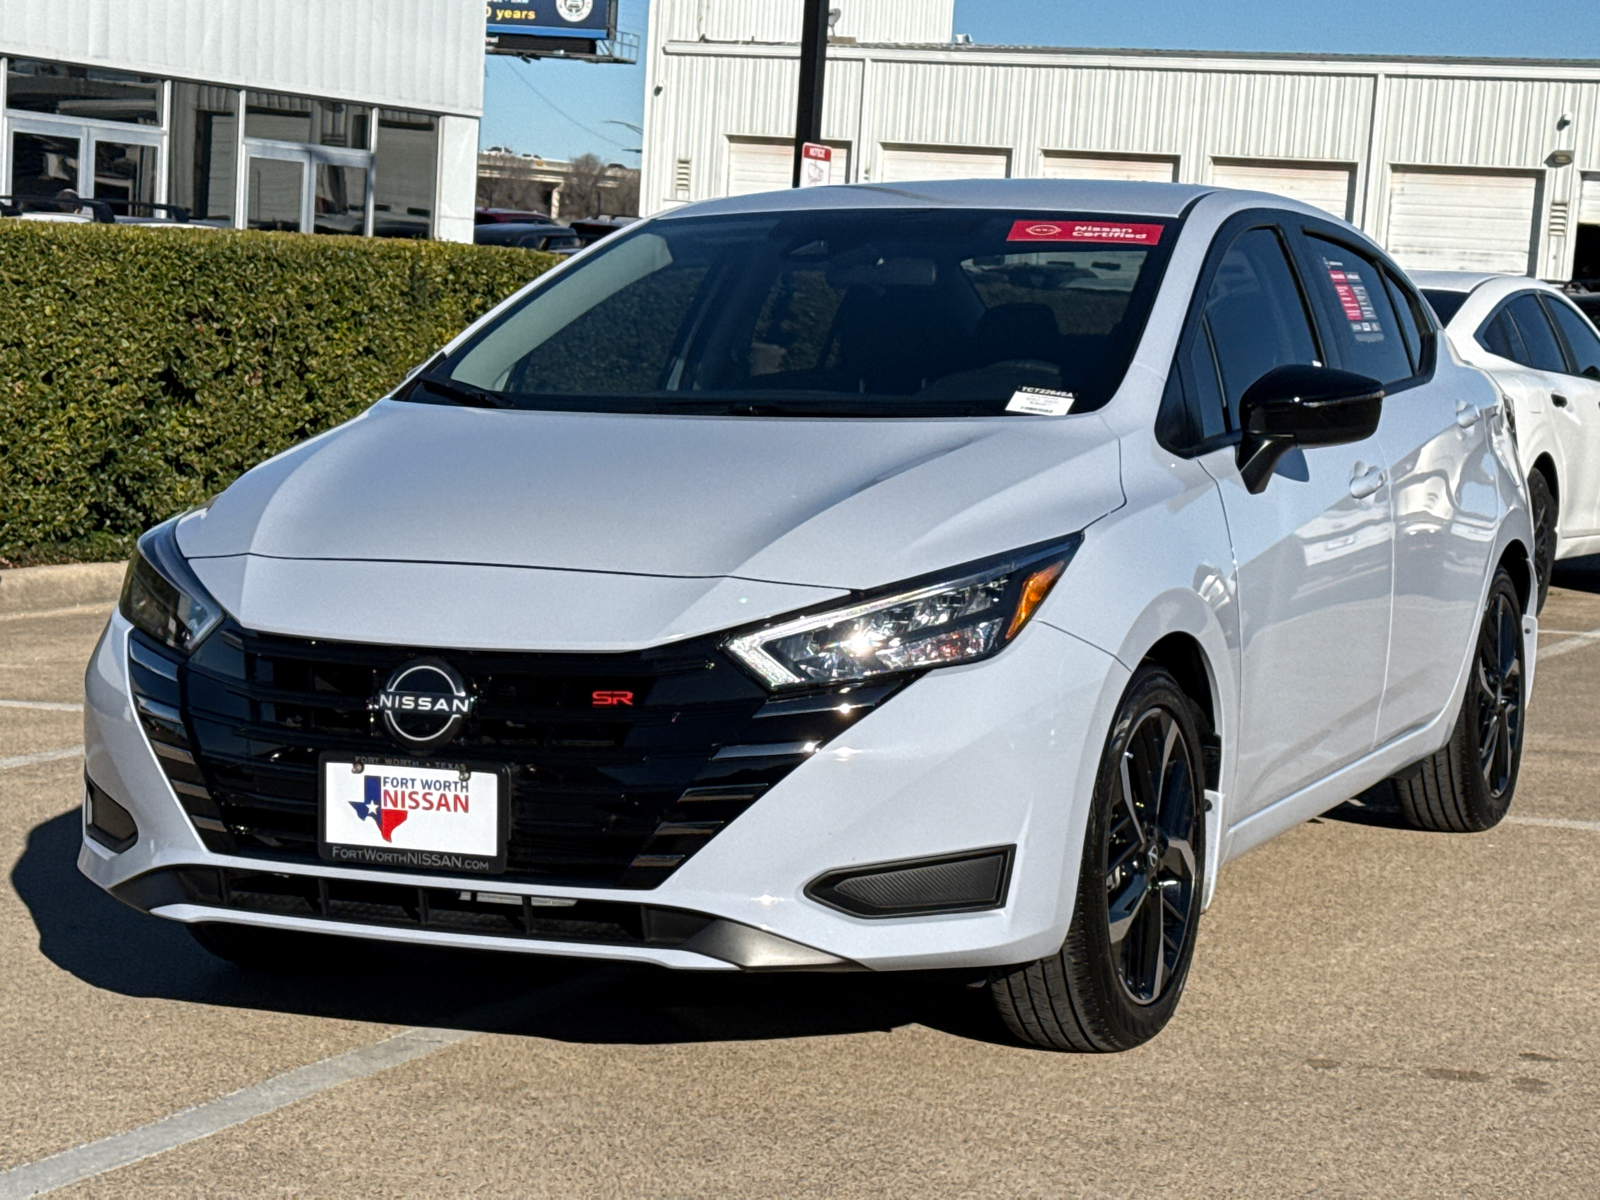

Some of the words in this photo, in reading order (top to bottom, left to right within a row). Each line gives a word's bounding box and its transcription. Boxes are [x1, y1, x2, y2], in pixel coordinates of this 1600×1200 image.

[496, 9, 536, 21] years
[1072, 231, 1148, 240] Certified
[1074, 225, 1133, 233] Nissan
[380, 694, 469, 712] NISSAN
[592, 690, 634, 705] SR
[354, 756, 380, 764] FORT
[384, 758, 420, 767] WORTH
[434, 761, 467, 771] TEXAS
[382, 776, 417, 790] FORT
[420, 779, 469, 793] WORTH
[383, 789, 469, 813] NISSAN
